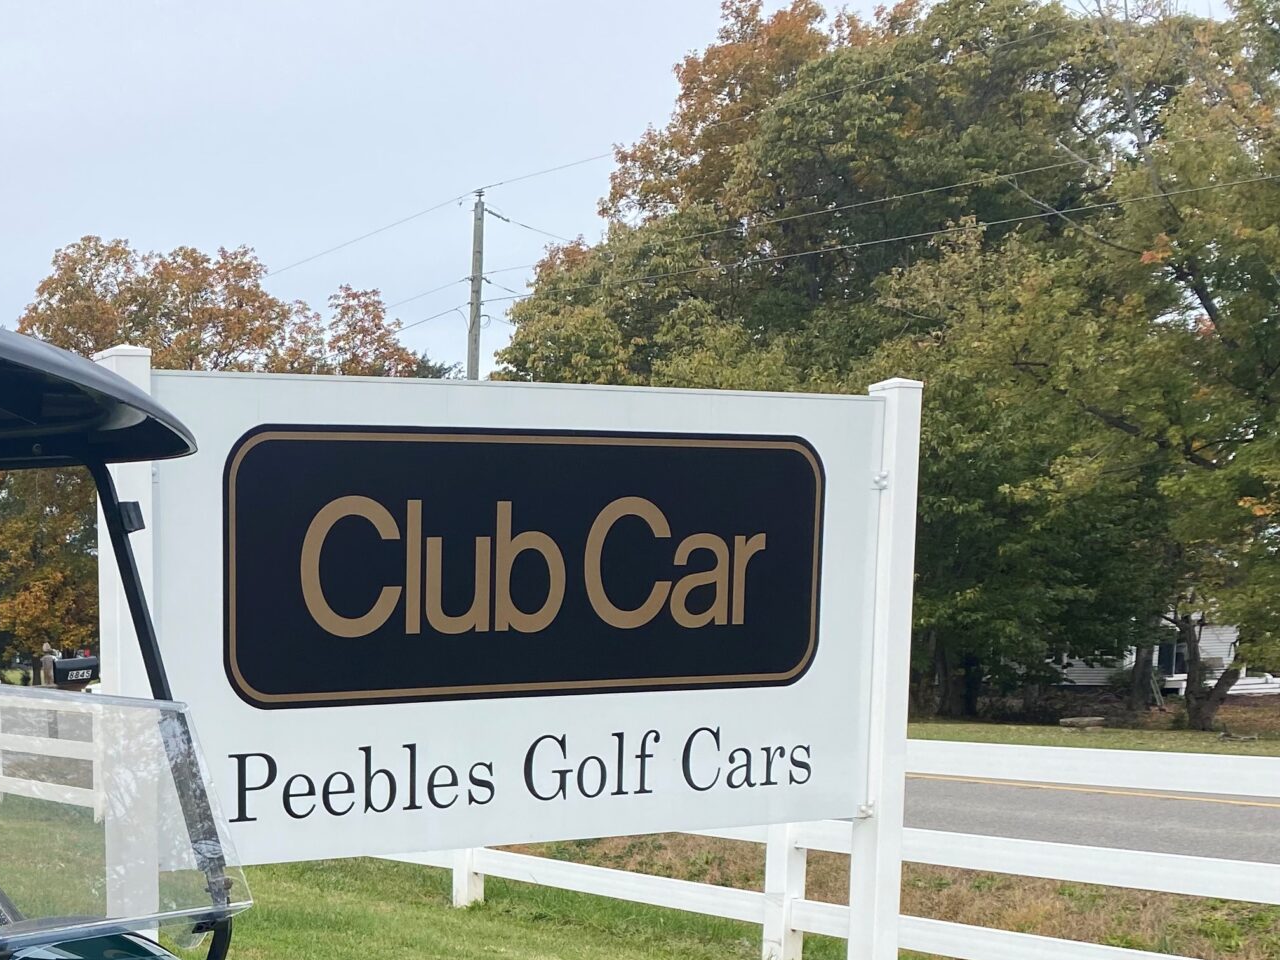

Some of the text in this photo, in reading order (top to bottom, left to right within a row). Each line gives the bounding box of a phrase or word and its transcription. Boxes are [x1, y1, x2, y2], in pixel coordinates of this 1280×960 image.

[300, 495, 767, 638] Club Car
[68, 670, 91, 680] 8845
[228, 726, 813, 823] Peebles Golf Cars
